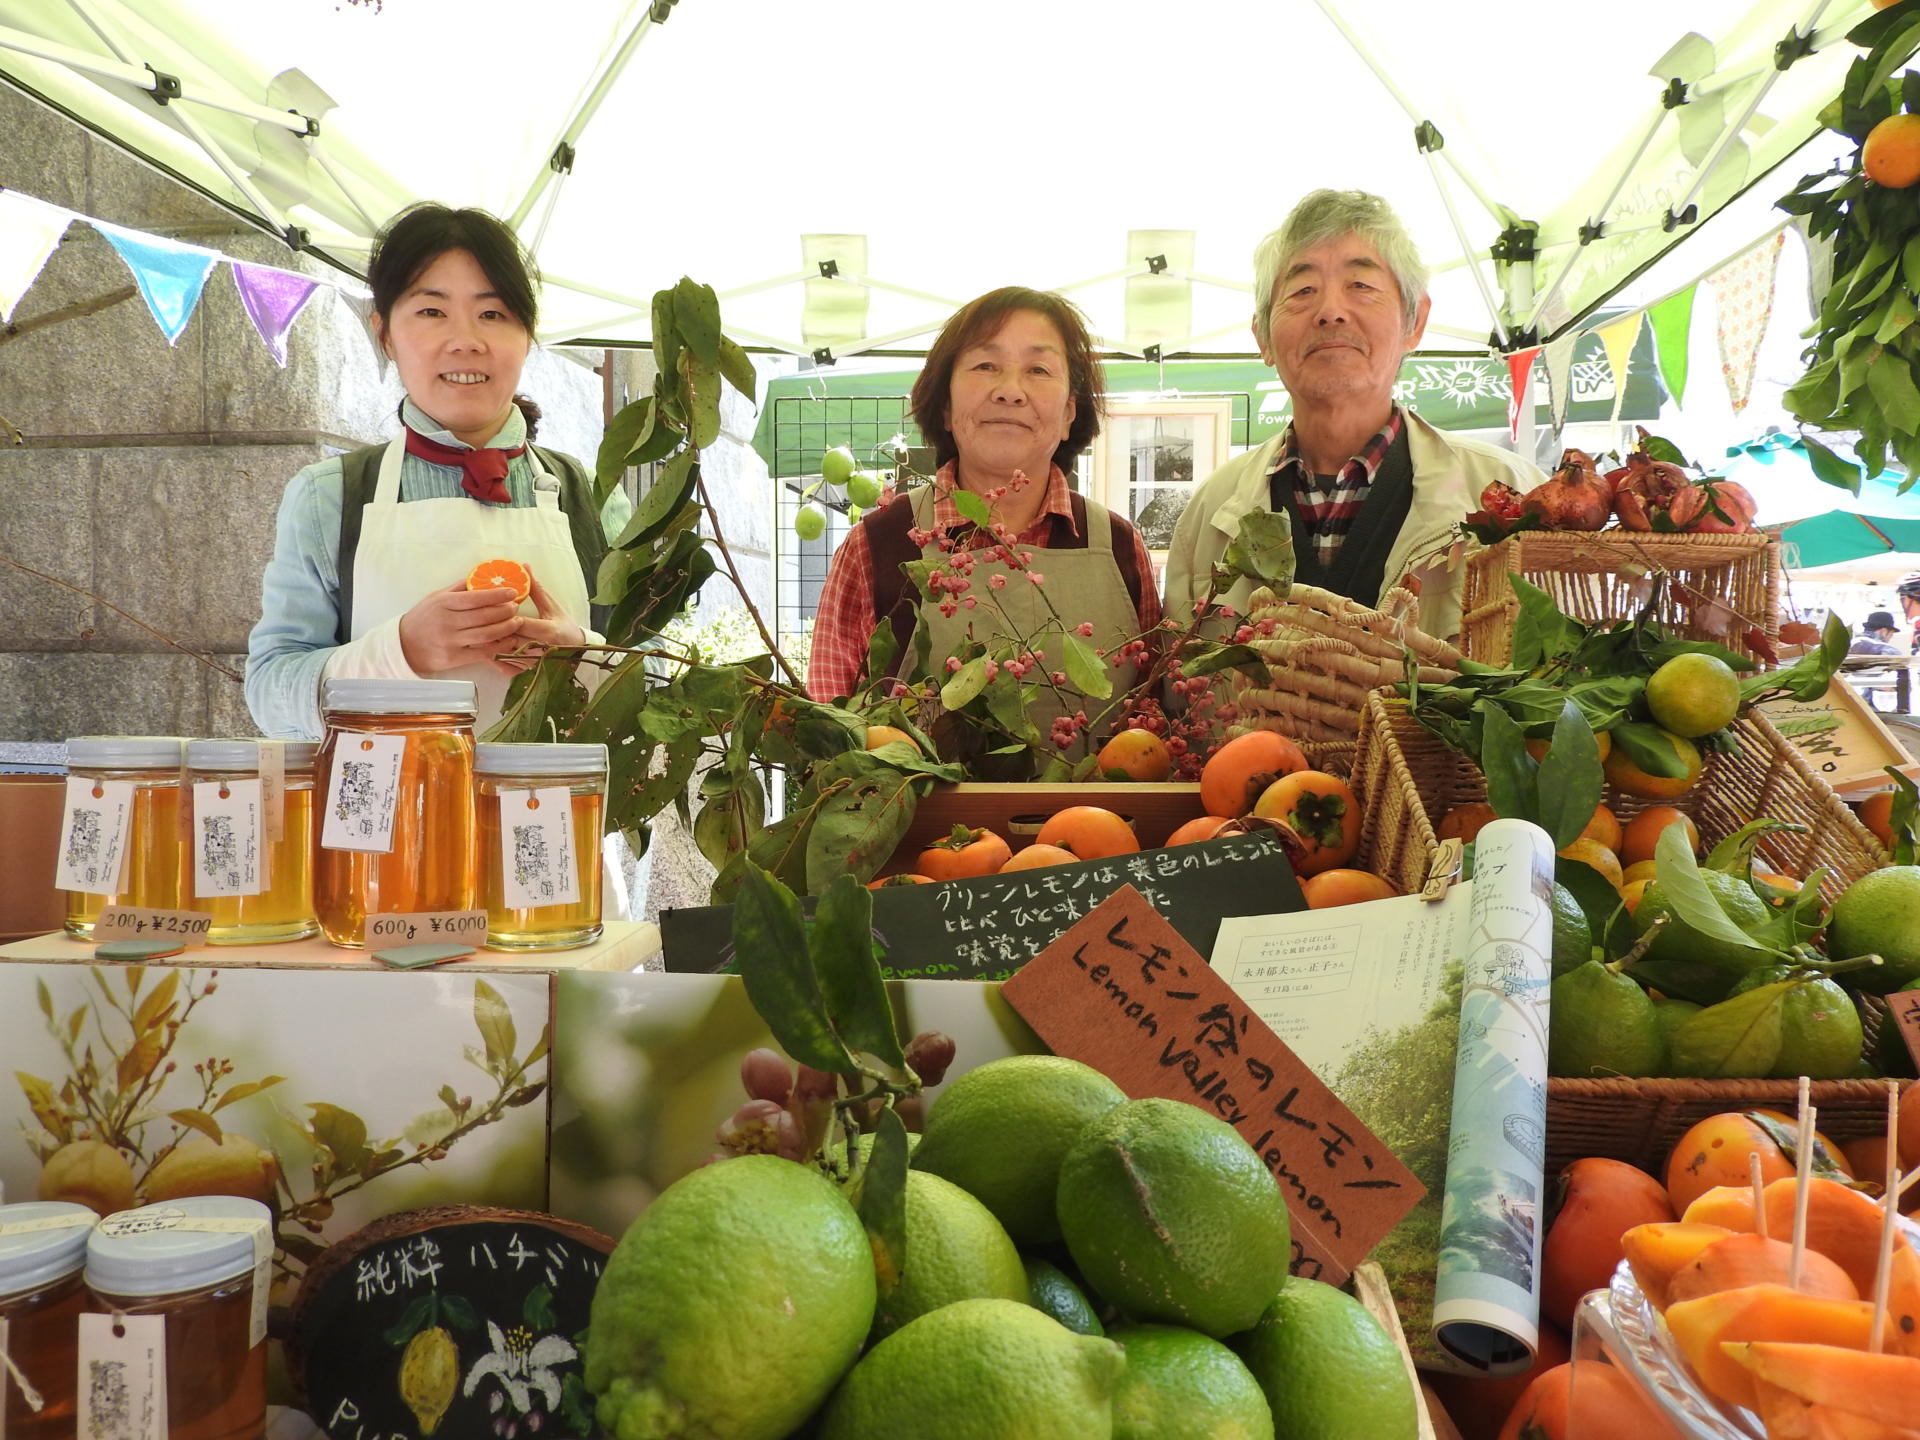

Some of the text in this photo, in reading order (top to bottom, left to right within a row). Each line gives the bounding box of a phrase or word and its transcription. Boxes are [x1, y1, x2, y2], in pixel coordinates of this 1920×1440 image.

[105, 914, 212, 933] 200g ¥2500
[373, 915, 487, 940] 600g ¥6000
[880, 963, 960, 979] emon
[1072, 941, 1159, 1038] Lemon
[356, 1236, 444, 1303] 純粋
